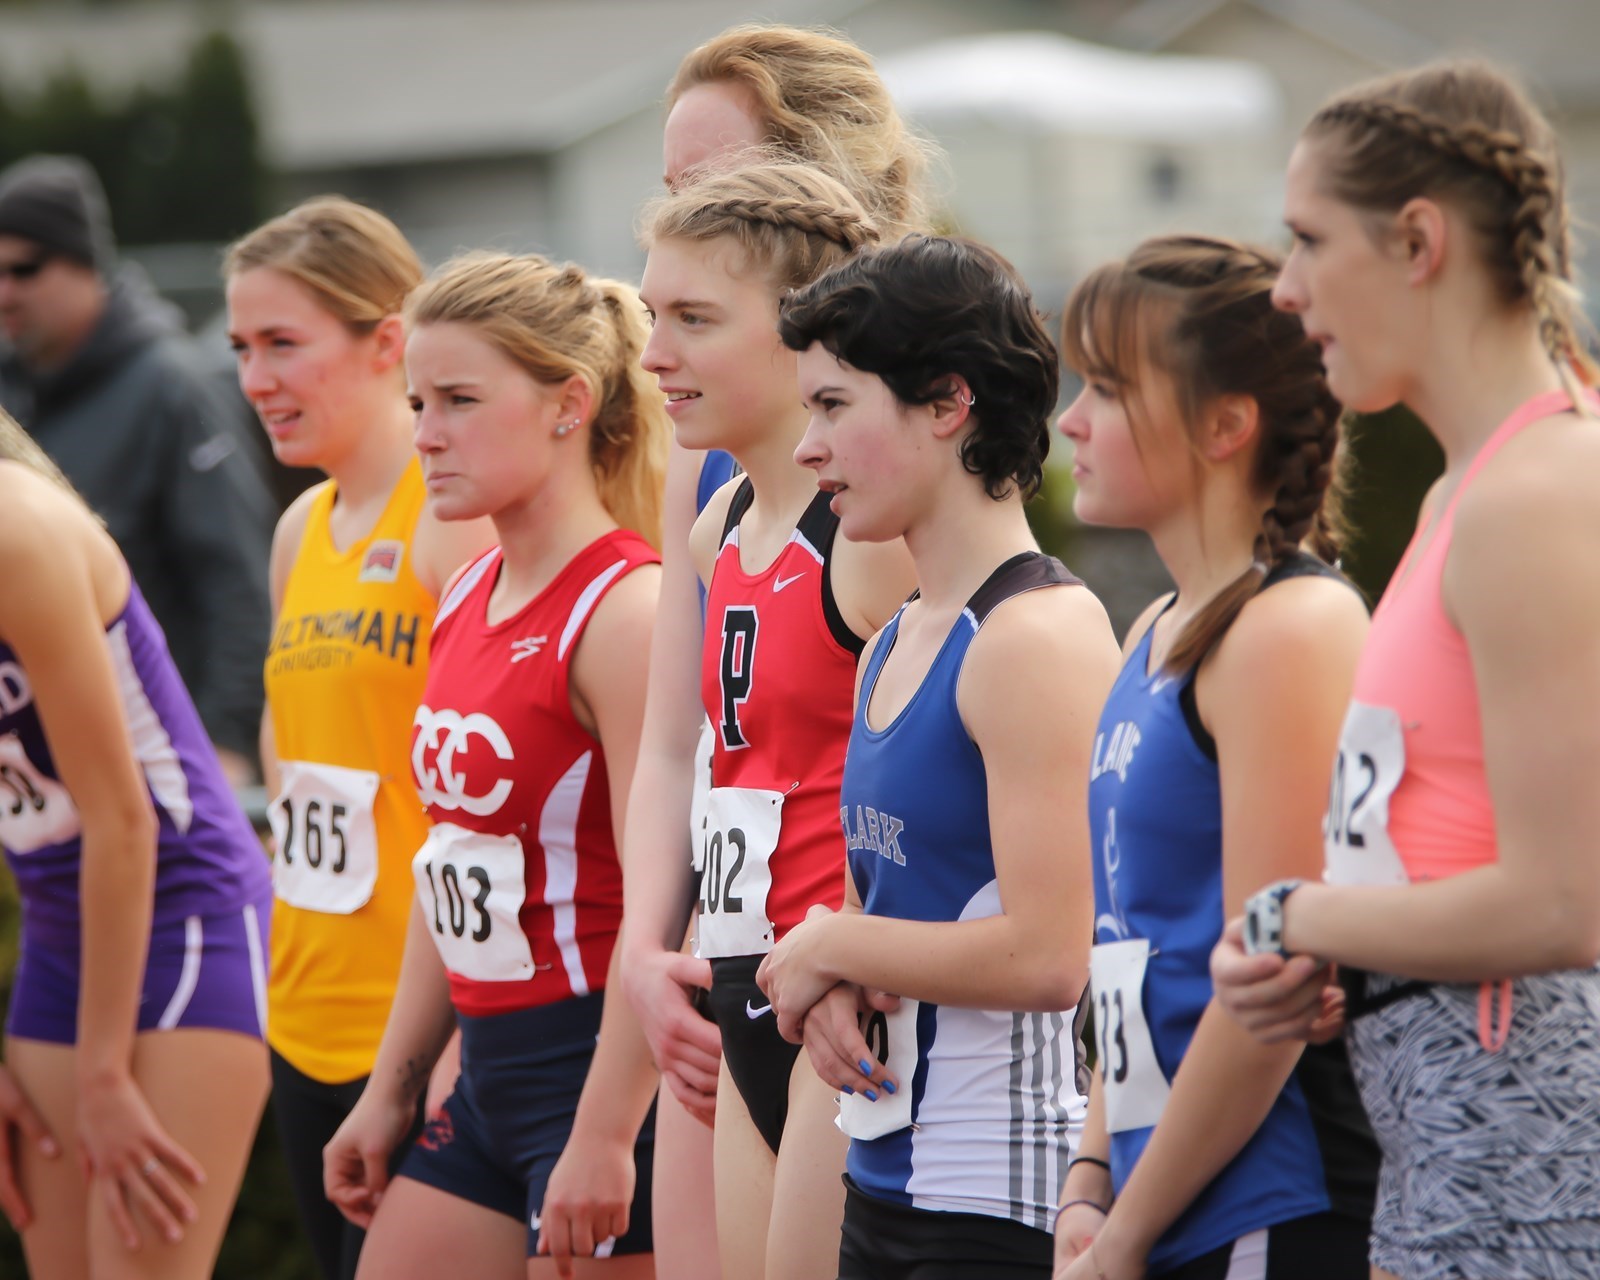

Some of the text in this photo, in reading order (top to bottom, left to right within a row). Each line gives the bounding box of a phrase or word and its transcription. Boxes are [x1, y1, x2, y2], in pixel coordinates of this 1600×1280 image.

[718, 604, 759, 752] P
[281, 798, 347, 873] 165
[840, 804, 907, 867] LARK
[425, 863, 493, 943] 103
